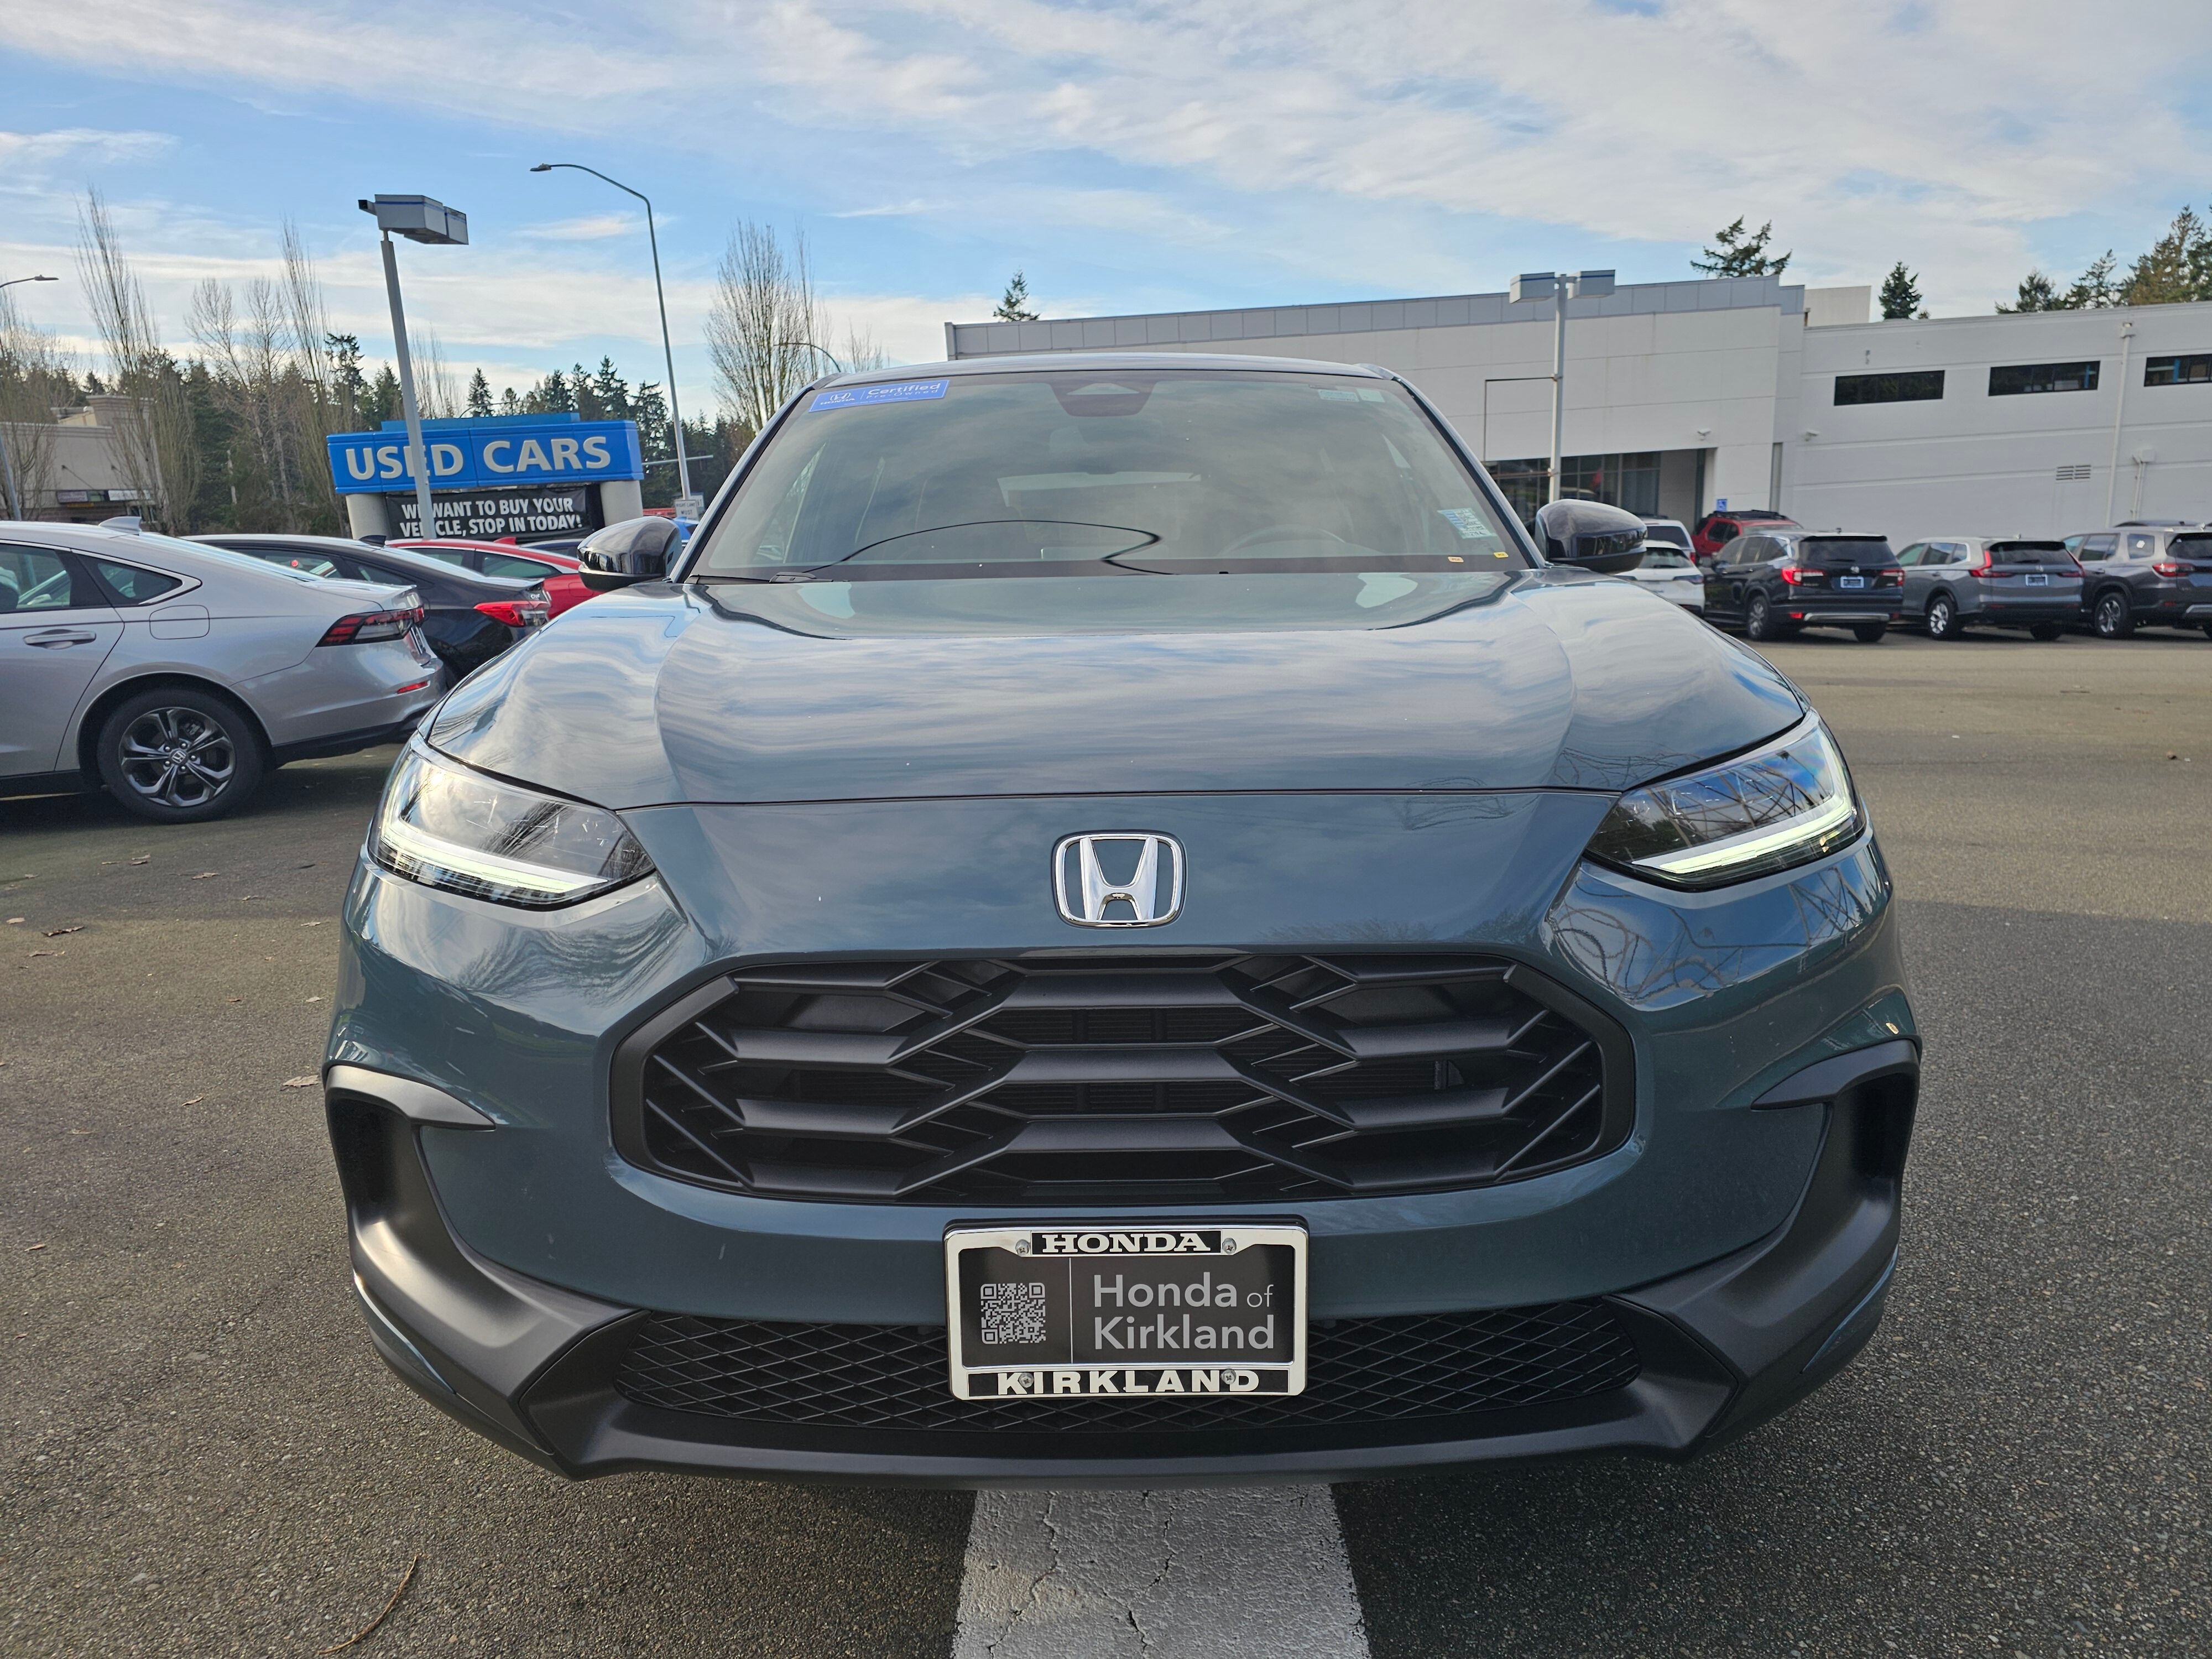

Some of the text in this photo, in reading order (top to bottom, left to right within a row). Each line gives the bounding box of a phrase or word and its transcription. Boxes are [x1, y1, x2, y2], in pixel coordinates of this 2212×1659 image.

[866, 389, 938, 399] Pre-Owned
[868, 383, 941, 395] Certified
[483, 436, 611, 473] CARS
[476, 500, 496, 516] TO
[499, 499, 529, 515] BUY
[533, 498, 573, 513] YOUR
[399, 514, 583, 538] VECLE, STOP IN TODAY!
[1041, 1233, 1211, 1253] HONDA
[1093, 1271, 1274, 1307] Honda of
[1094, 1314, 1274, 1349] Kirkland
[997, 1369, 1259, 1395] KIRKLAND
